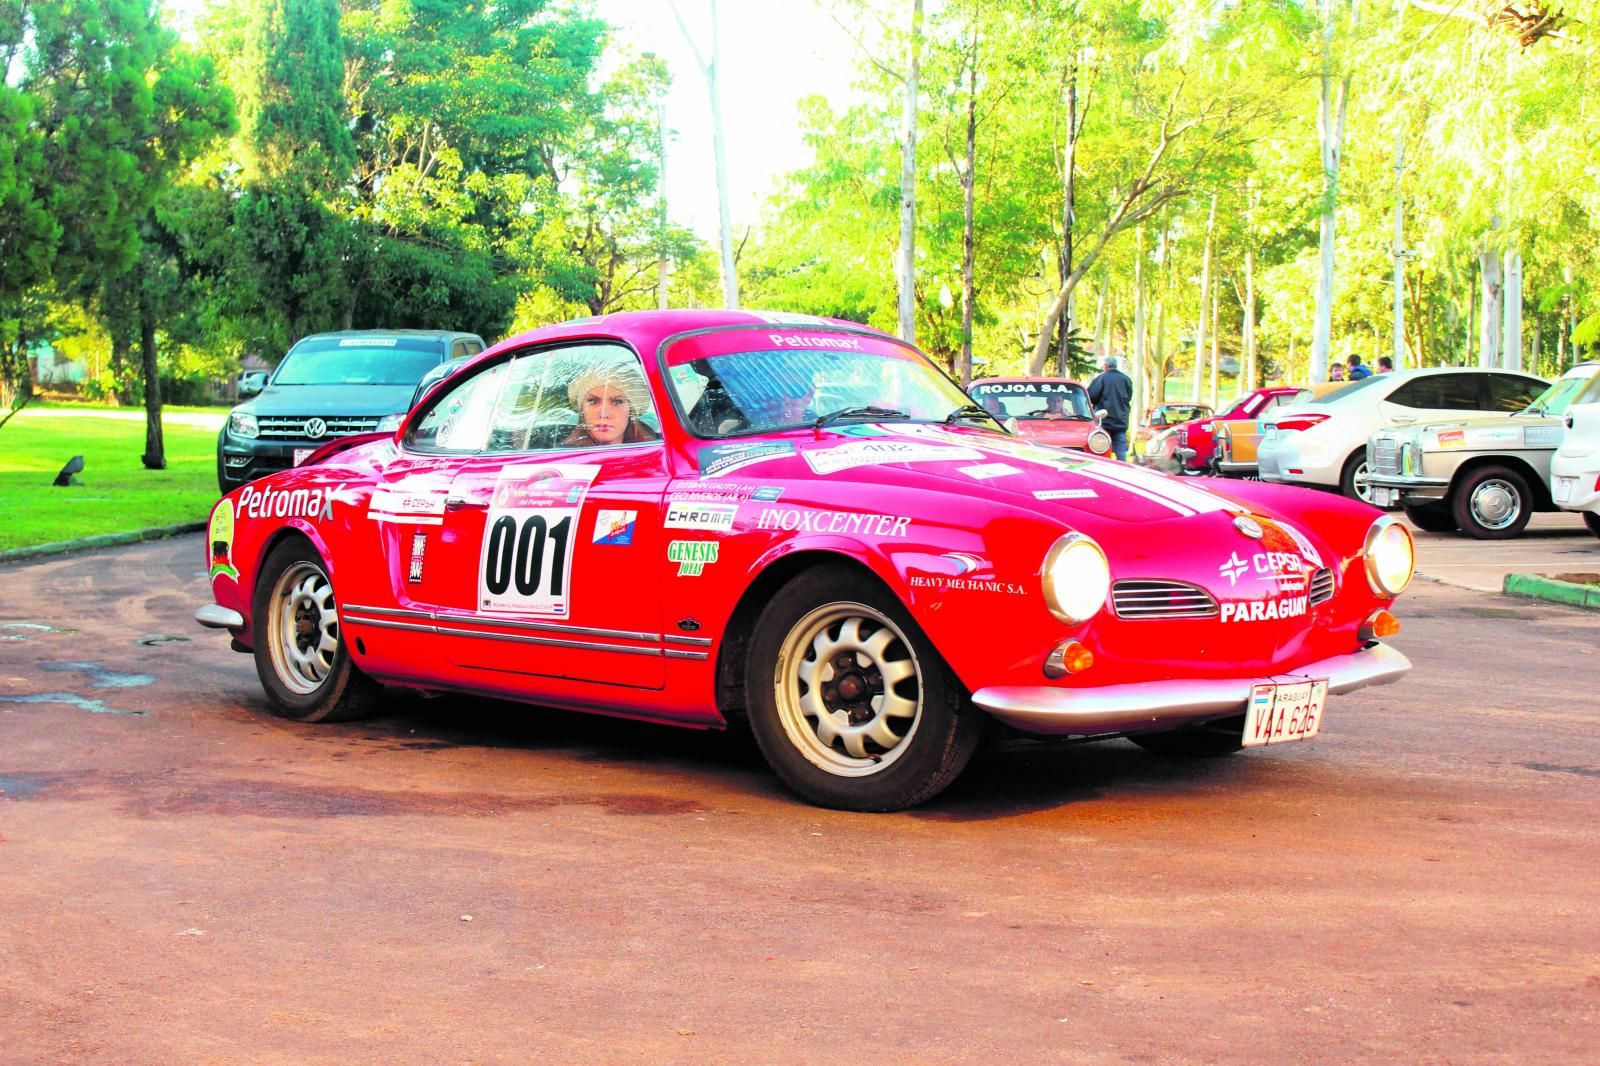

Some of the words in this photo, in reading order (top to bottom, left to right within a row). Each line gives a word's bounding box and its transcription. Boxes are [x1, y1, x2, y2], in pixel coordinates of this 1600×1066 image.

[980, 384, 1037, 394] ROJOA
[1041, 384, 1073, 394] S.A.
[668, 511, 732, 525] CHROMA
[757, 509, 912, 537] INOXCENTER
[486, 515, 572, 596] 001
[669, 542, 718, 562] GENESIS
[679, 562, 703, 575] JOYAS
[1253, 552, 1302, 573] CEPSA
[910, 577, 944, 587] HEAVY
[946, 579, 1005, 592] MECHANIC
[1006, 583, 1027, 594] S.A.
[1221, 596, 1307, 623] PARAGUAY
[1255, 707, 1284, 738] VAA
[1289, 703, 1317, 735] 626
